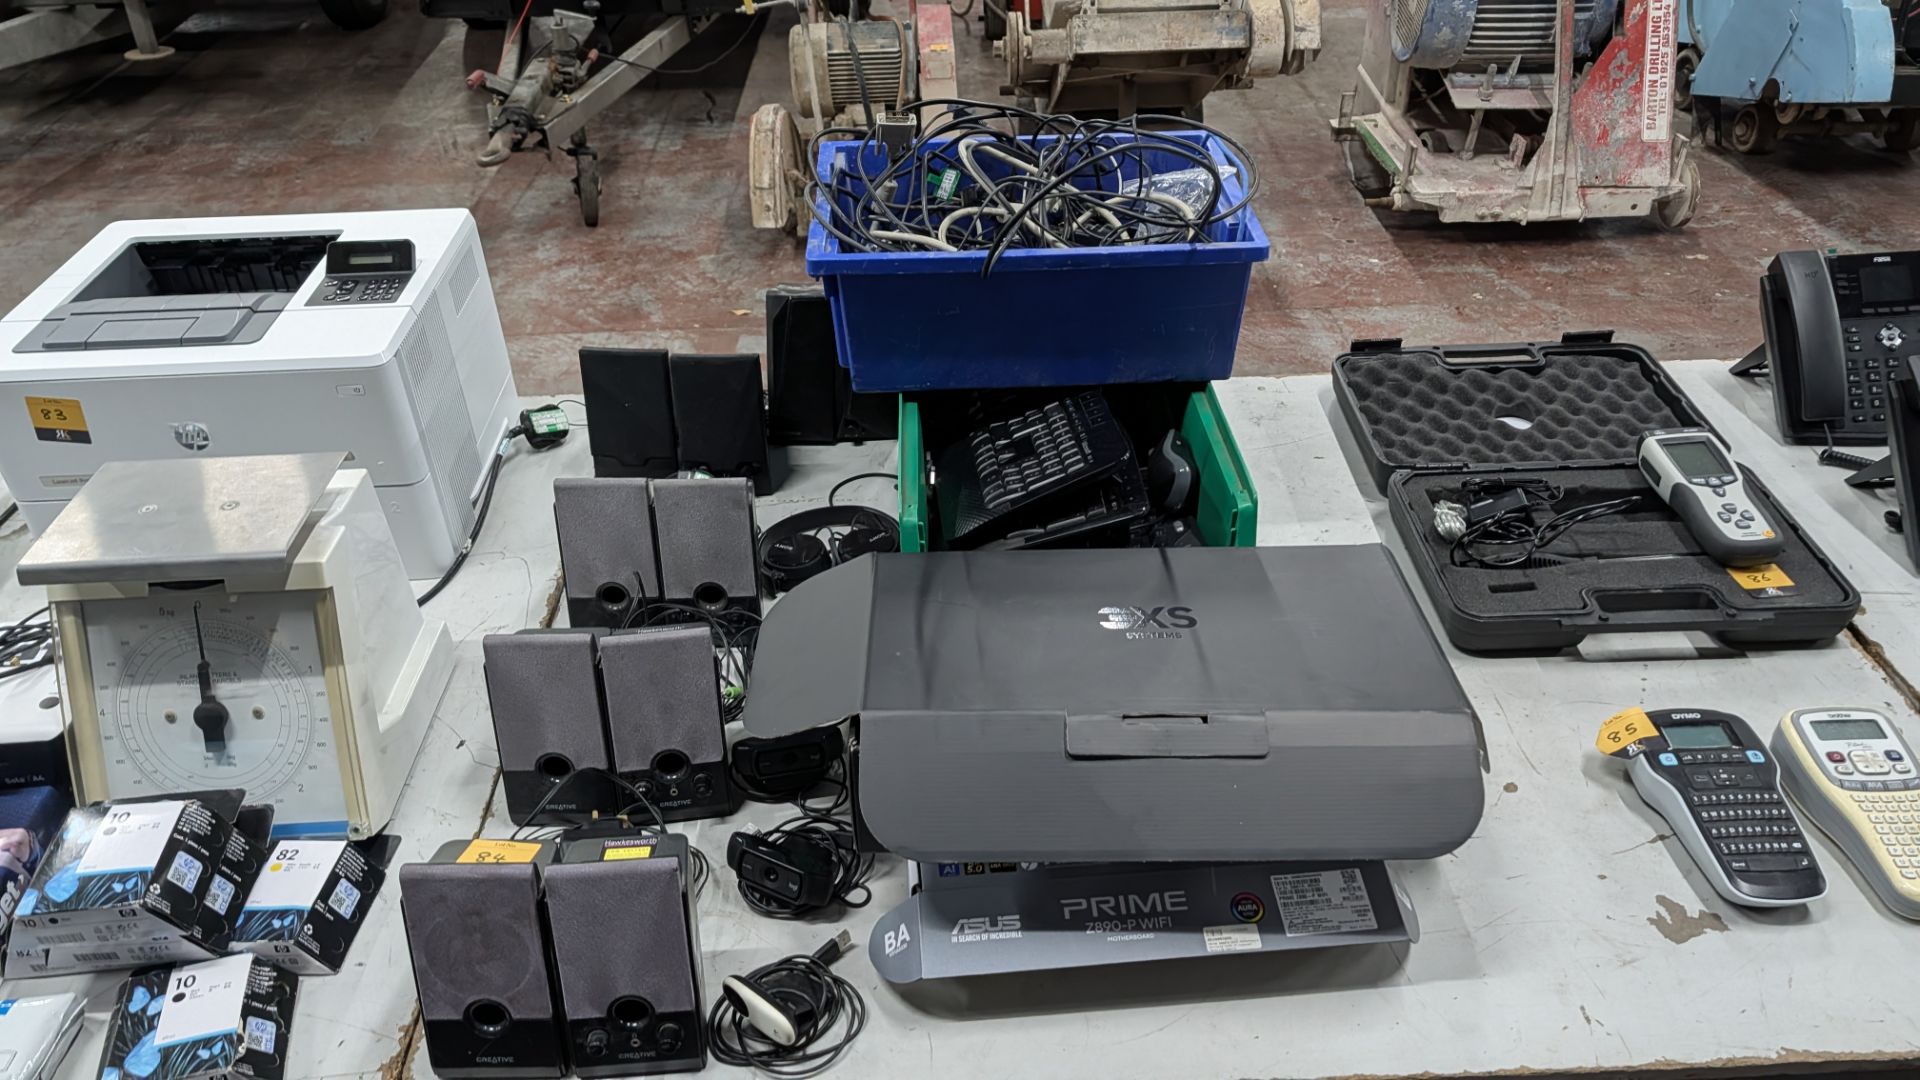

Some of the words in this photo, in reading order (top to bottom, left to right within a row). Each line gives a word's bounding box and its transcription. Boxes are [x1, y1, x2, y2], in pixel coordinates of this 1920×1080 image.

[1662, 4, 1672, 48] 653354
[1648, 15, 1662, 75] DRILLING
[1660, 52, 1669, 89] 01925
[1645, 79, 1659, 131] BARTON
[1658, 92, 1668, 115] TEL:
[40, 408, 68, 421] 83
[1747, 574, 1772, 583] 86
[99, 708, 106, 717] 4
[1607, 722, 1638, 743] 85
[298, 783, 305, 793] 2
[110, 812, 131, 824] 10
[276, 849, 299, 860] 82
[476, 851, 507, 862] 84
[944, 866, 956, 874] AI
[967, 865, 983, 873] 5.0
[1060, 891, 1189, 920] PRIME
[1237, 904, 1258, 912] AURA
[21, 918, 37, 928] 10
[951, 914, 1022, 935] ASUS
[1085, 919, 1136, 934] Z890-P
[1138, 916, 1173, 930] WIFI
[884, 922, 911, 955] BA
[951, 935, 958, 943] IN
[959, 933, 981, 942] SEARCH
[981, 932, 989, 941] OF
[989, 930, 1023, 940] INCREDIBLE
[1107, 933, 1155, 942] MOTHERBOARD
[175, 974, 197, 990] 10
[618, 1051, 656, 1060] CREATIVE
